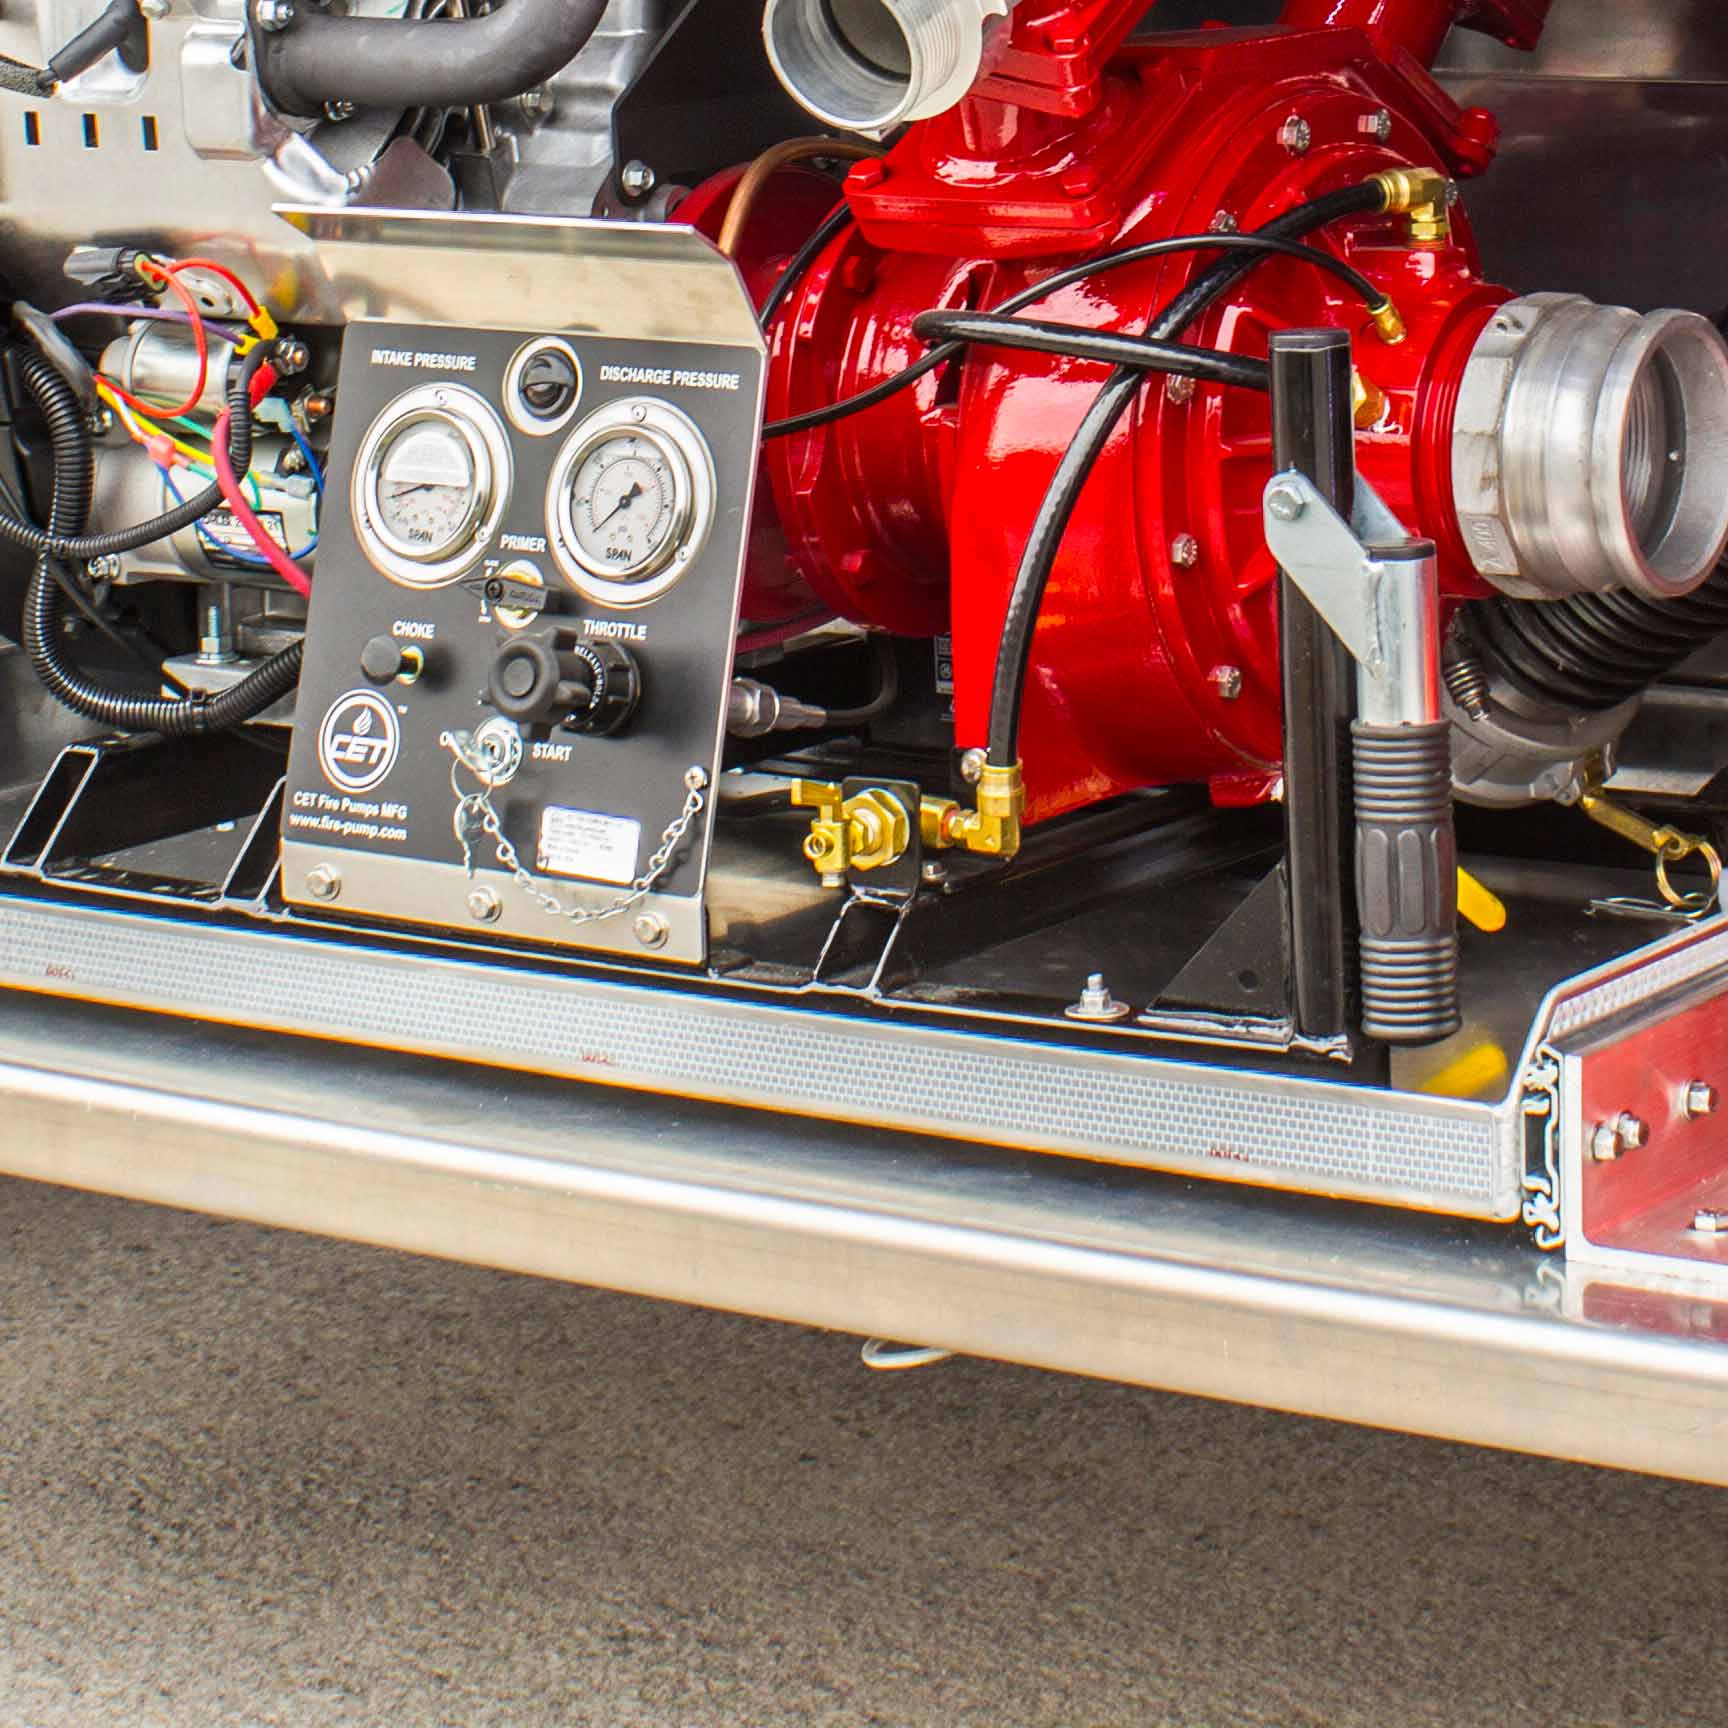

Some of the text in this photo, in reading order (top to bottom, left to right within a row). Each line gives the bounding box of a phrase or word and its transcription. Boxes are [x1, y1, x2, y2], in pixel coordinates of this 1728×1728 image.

[370, 349, 477, 371] INTAKE PRESSURE
[600, 365, 740, 390] DISCHARGE PRESSURE
[500, 534, 547, 553] PRIMER
[605, 547, 633, 562] SPAN
[392, 620, 436, 640] CHOKE
[583, 619, 648, 641] THROTTLE
[330, 733, 388, 765] CET
[532, 742, 573, 762] START
[293, 790, 408, 820] CET Fire Pumps MFG
[289, 813, 408, 841] www.fire-pump.com
